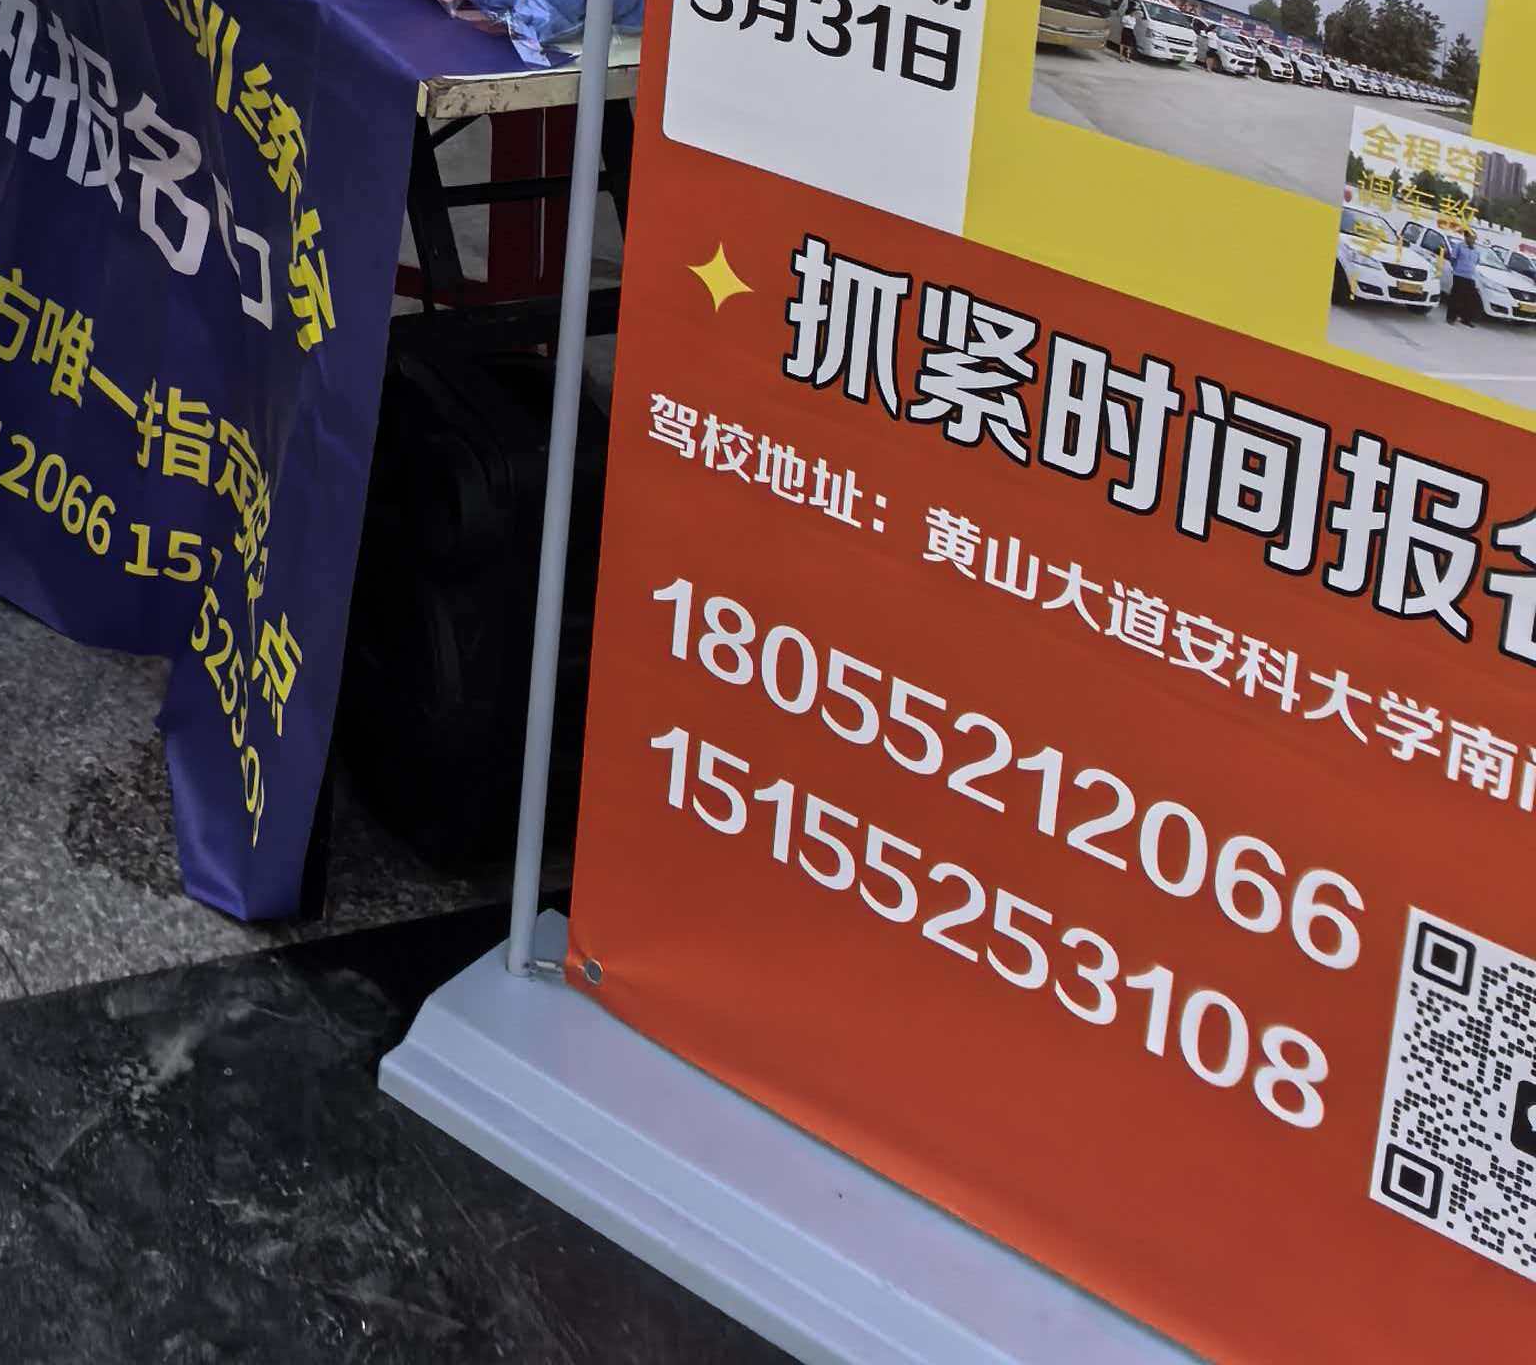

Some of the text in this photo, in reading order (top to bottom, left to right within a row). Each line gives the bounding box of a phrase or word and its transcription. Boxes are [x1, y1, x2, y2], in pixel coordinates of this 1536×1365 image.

[1362, 123, 1484, 187] 全程空
[650, 727, 1330, 1130] 15155253108
[653, 577, 1366, 970] 18055212066
